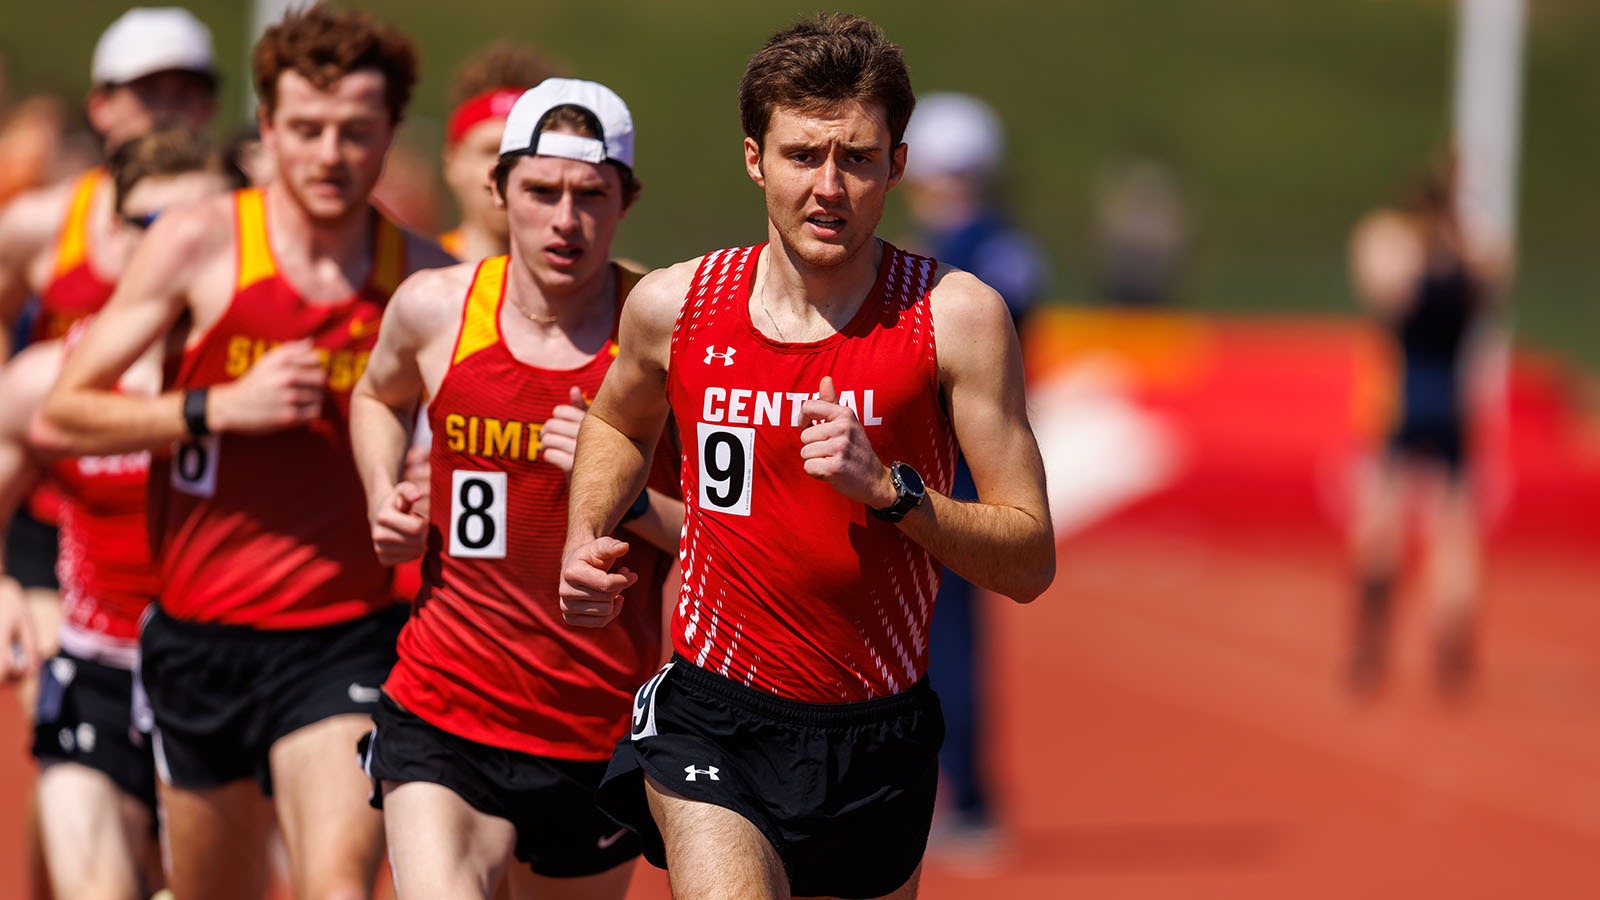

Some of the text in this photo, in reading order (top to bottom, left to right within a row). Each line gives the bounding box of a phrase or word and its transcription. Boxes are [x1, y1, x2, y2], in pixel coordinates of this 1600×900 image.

[702, 386, 883, 427] CENTAL
[703, 430, 746, 508] 9
[457, 478, 496, 549] 8
[632, 667, 669, 735] 9
